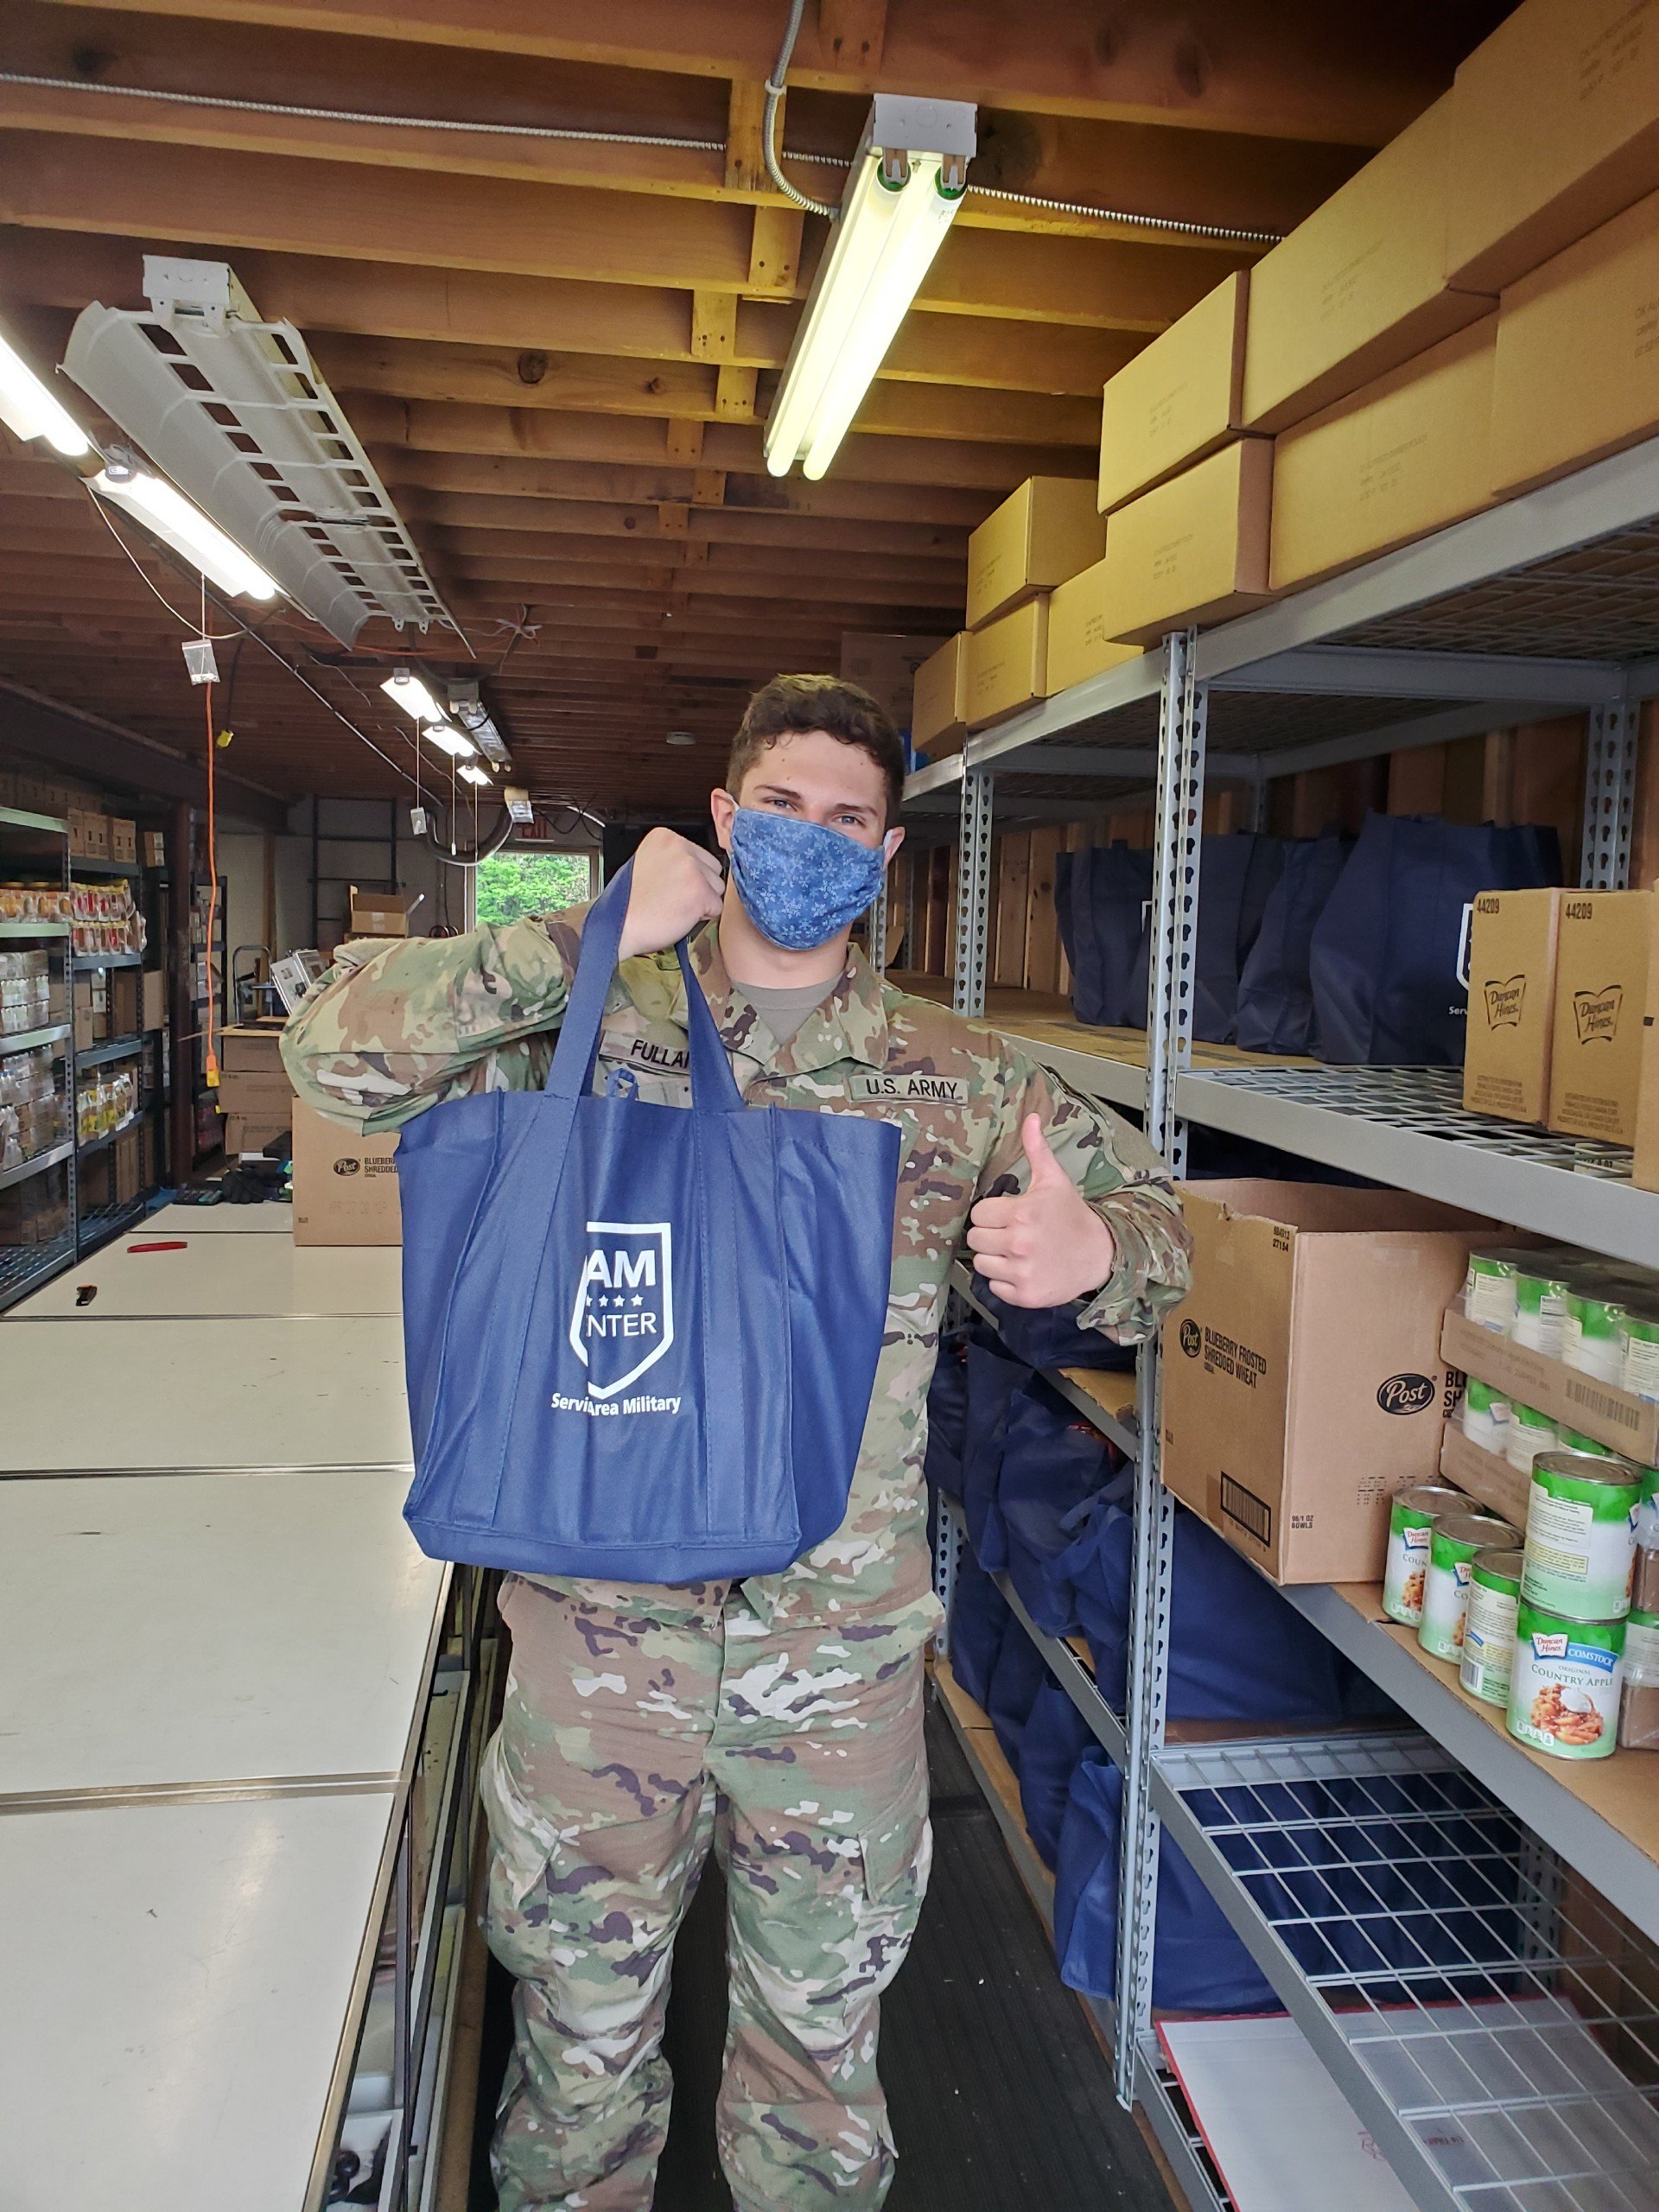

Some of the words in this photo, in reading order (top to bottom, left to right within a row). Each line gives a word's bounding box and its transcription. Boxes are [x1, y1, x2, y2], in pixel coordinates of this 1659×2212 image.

[1477, 899, 1500, 913] 44209
[1565, 903, 1592, 919] 44209
[1490, 988, 1520, 1005] Duncan
[1494, 1002, 1519, 1020] Hines
[1580, 1000, 1615, 1018] Duncan
[1583, 1015, 1614, 1034] Hines
[631, 1039, 690, 1068] FULLA
[866, 1077, 900, 1095] U.S.
[907, 1078, 957, 1099] ARMY
[337, 1161, 357, 1173] Post
[1272, 1238, 1289, 1252] 27154
[587, 1249, 656, 1287] AM
[586, 1312, 658, 1338] NTER
[1182, 1324, 1199, 1348] Post
[1205, 1326, 1238, 1359] BLUEBERRY
[1238, 1344, 1267, 1376] FROSTED
[1205, 1345, 1234, 1376] SHREDDED
[1236, 1363, 1257, 1389] WHEAT
[1386, 1380, 1427, 1408] Post
[623, 1395, 681, 1414] Military
[1536, 1637, 1563, 1646] Duncan
[1541, 1644, 1561, 1653] Hines
[1567, 1649, 1614, 1667] COMSTOCK
[1531, 1664, 1584, 1686] COUNTRY
[1586, 1677, 1613, 1687] APPLE
[1558, 1666, 1591, 1675] ORIGINAL
